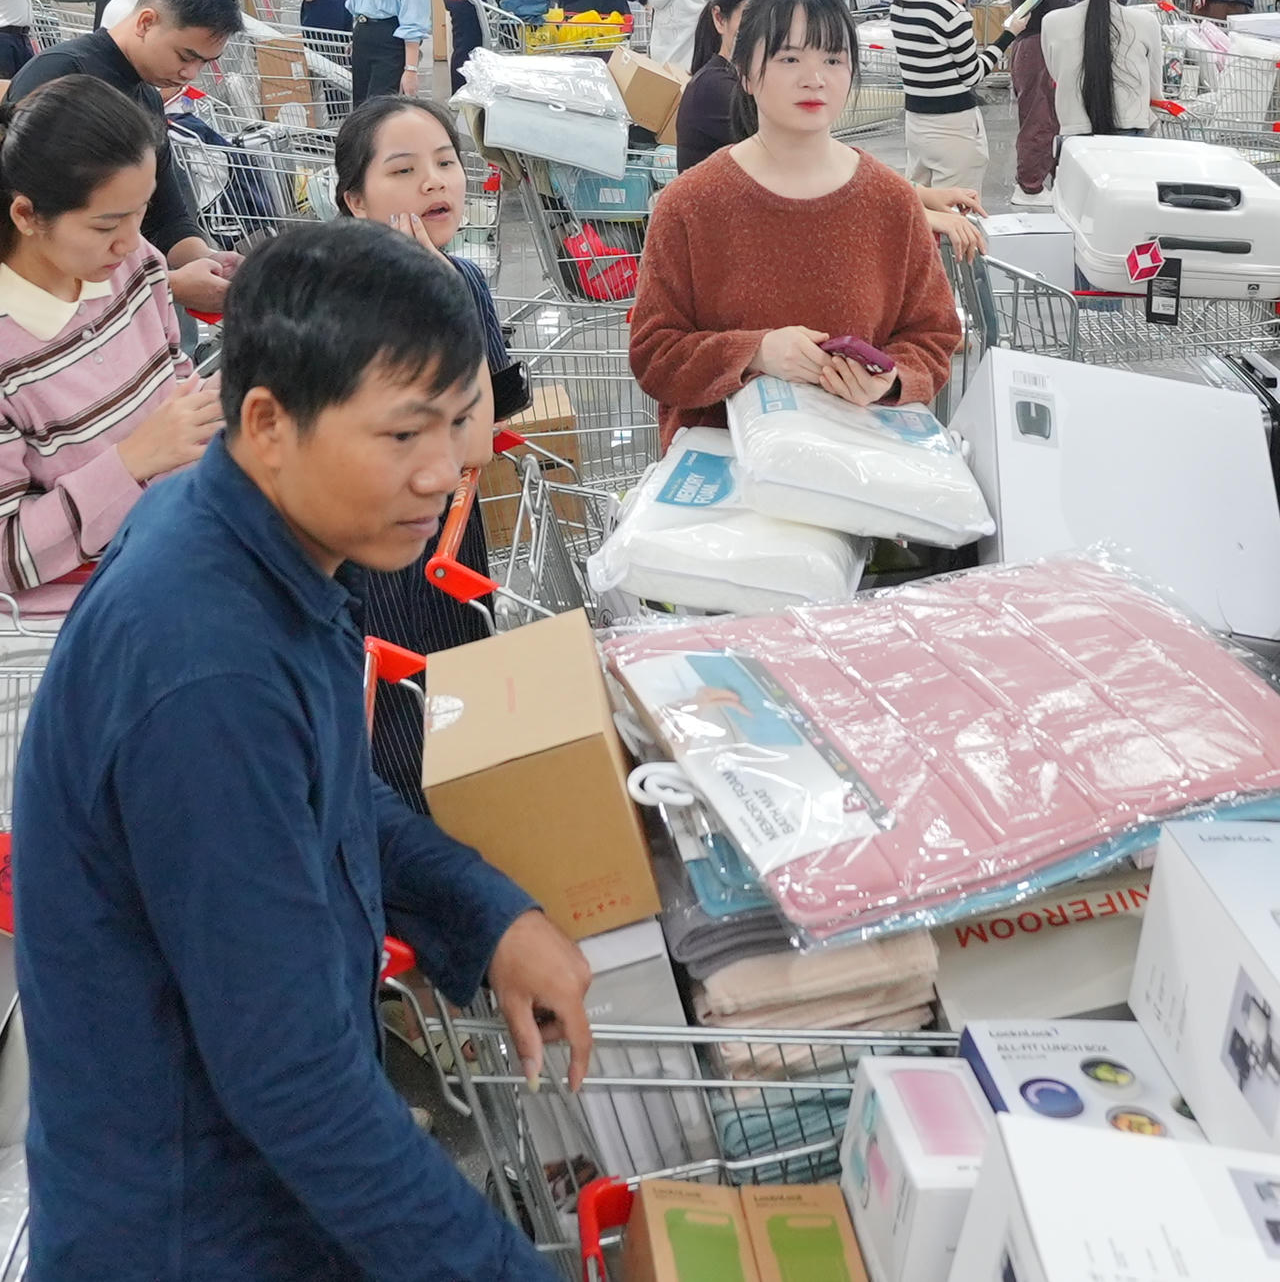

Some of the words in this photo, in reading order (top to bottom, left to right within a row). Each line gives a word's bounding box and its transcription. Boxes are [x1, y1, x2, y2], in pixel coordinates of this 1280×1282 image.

[673, 471, 705, 503] MEMORY
[695, 483, 721, 505] FOAM
[1198, 833, 1273, 845] LocknLock
[988, 1028, 1054, 1039] LocknLock
